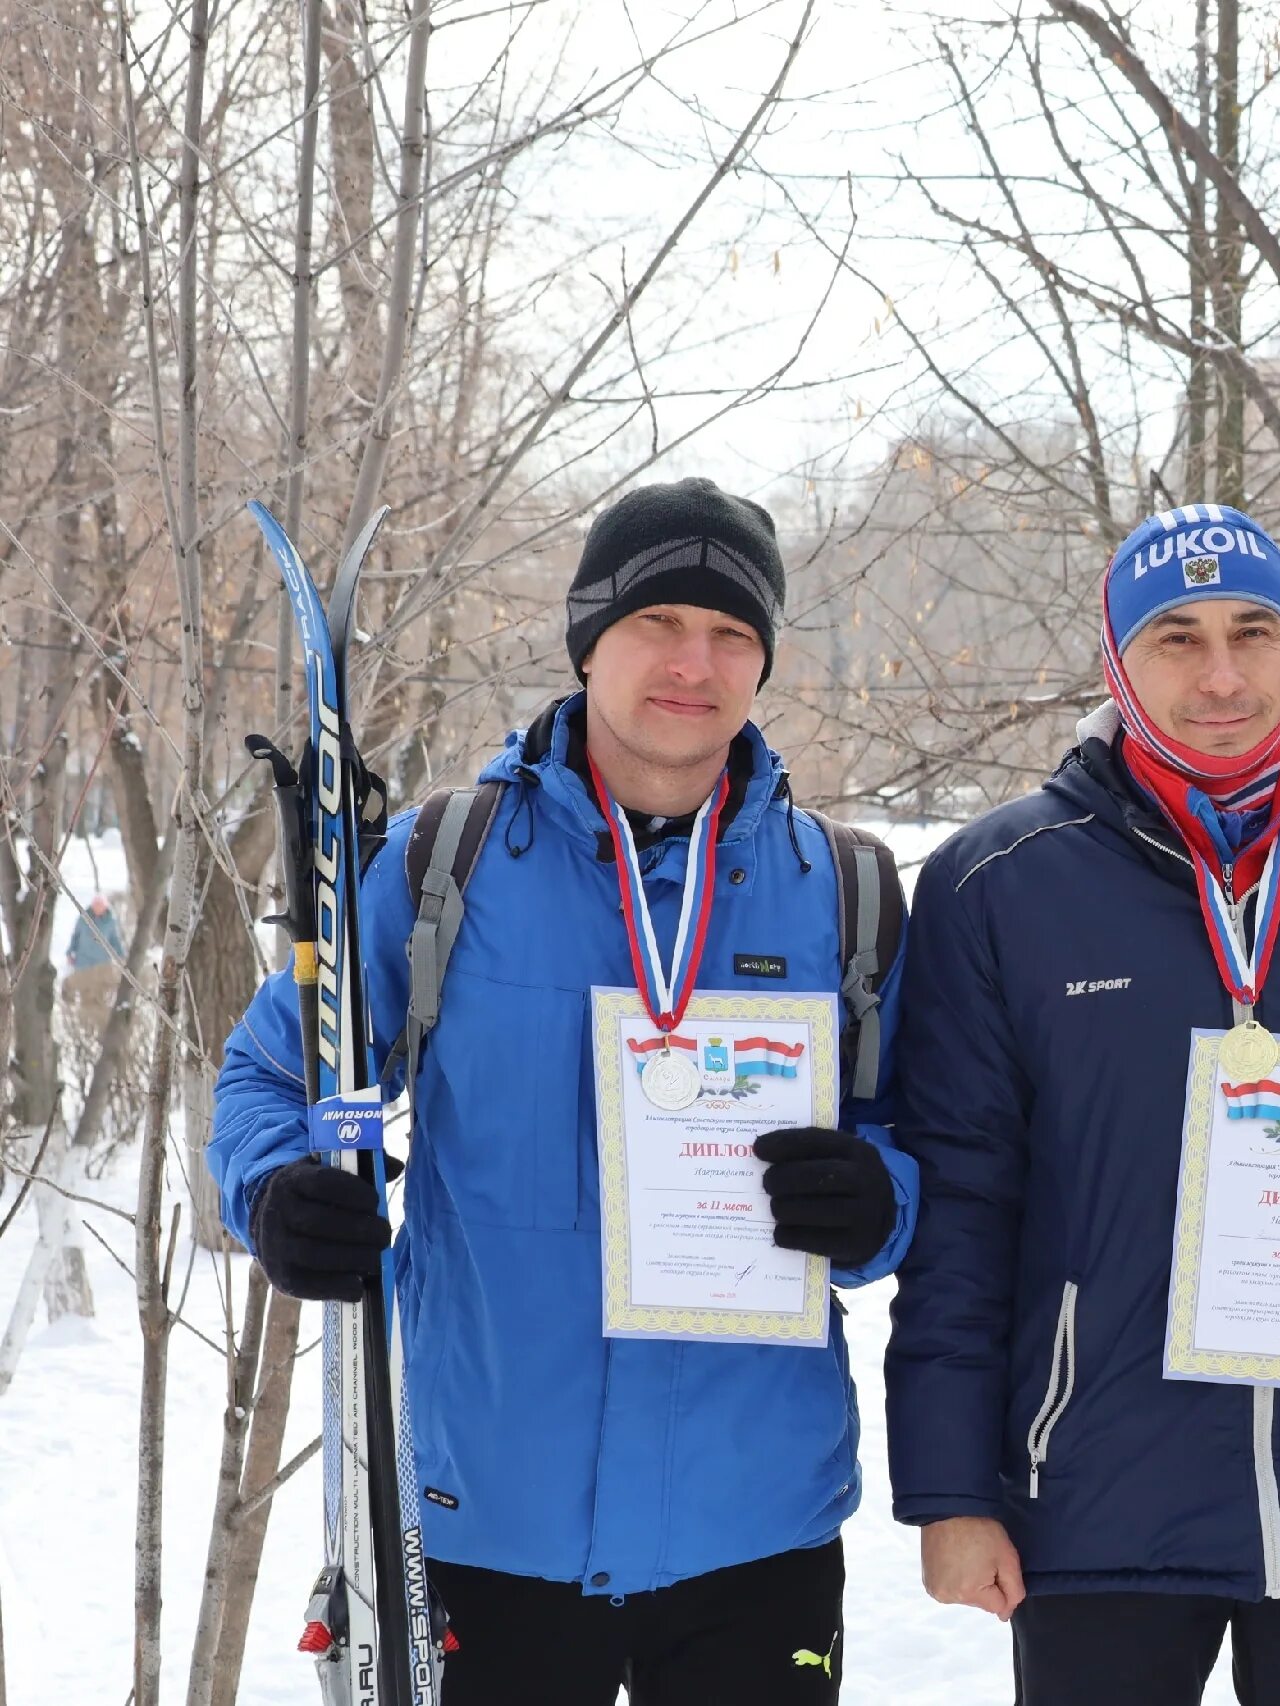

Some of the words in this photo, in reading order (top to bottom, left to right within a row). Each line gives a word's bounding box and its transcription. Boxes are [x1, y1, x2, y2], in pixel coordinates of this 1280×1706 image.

[1134, 527, 1267, 580] LUKOIL
[276, 546, 314, 665] TRACK
[312, 649, 342, 1073] motor
[1088, 978, 1132, 993] SPORT
[321, 1110, 382, 1121] NORDWAY
[694, 1168, 753, 1179] Награждается
[696, 1201, 706, 1209] за
[723, 1202, 752, 1211] место
[352, 1512, 360, 1589] CONSTRUCTION
